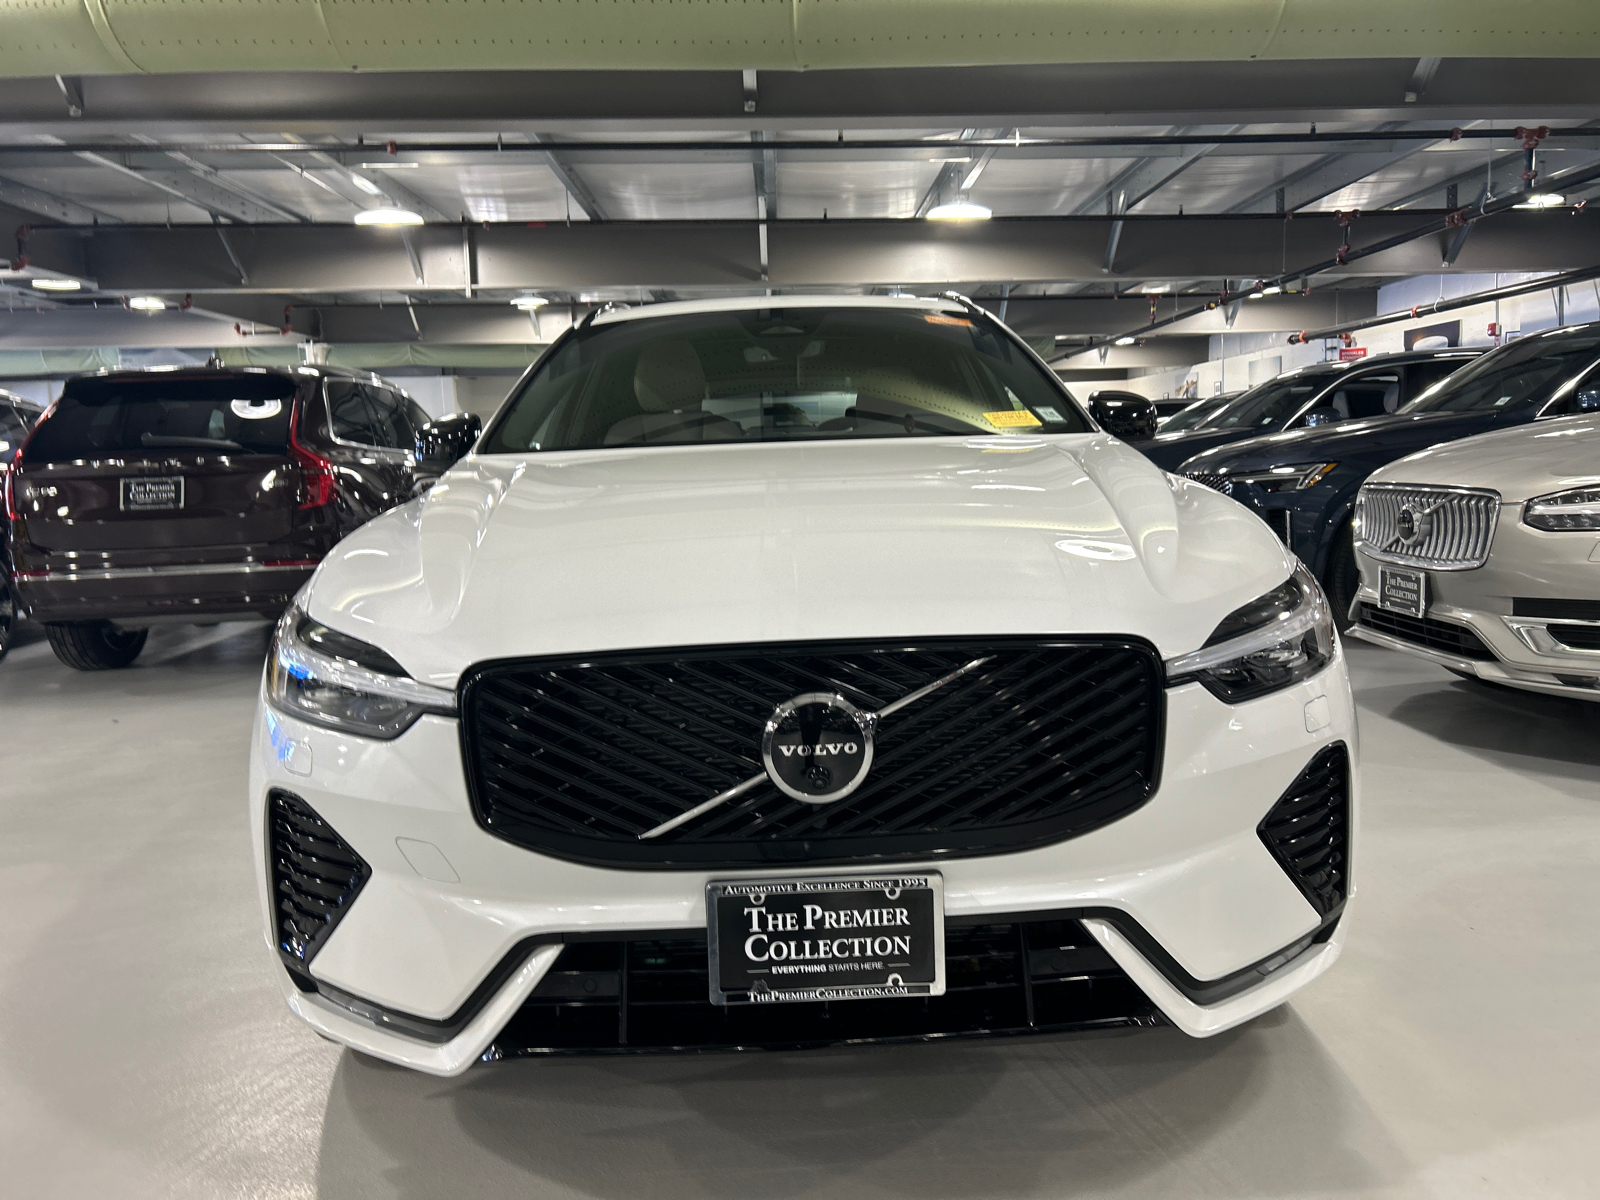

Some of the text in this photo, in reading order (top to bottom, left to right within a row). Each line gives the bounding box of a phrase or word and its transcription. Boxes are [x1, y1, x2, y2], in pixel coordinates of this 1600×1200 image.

[1386, 575, 1418, 590] THE PREMIER
[1385, 585, 1418, 600] COLLECTION
[778, 742, 858, 757] VOLVO
[724, 877, 926, 896] AUTOMOTIVE EXCELLENCE SINCE 1995
[743, 904, 911, 933] THE PREMIER
[744, 934, 912, 962] COLLECTION
[771, 963, 827, 975] EVERYTHING
[828, 962, 860, 972] STARTS
